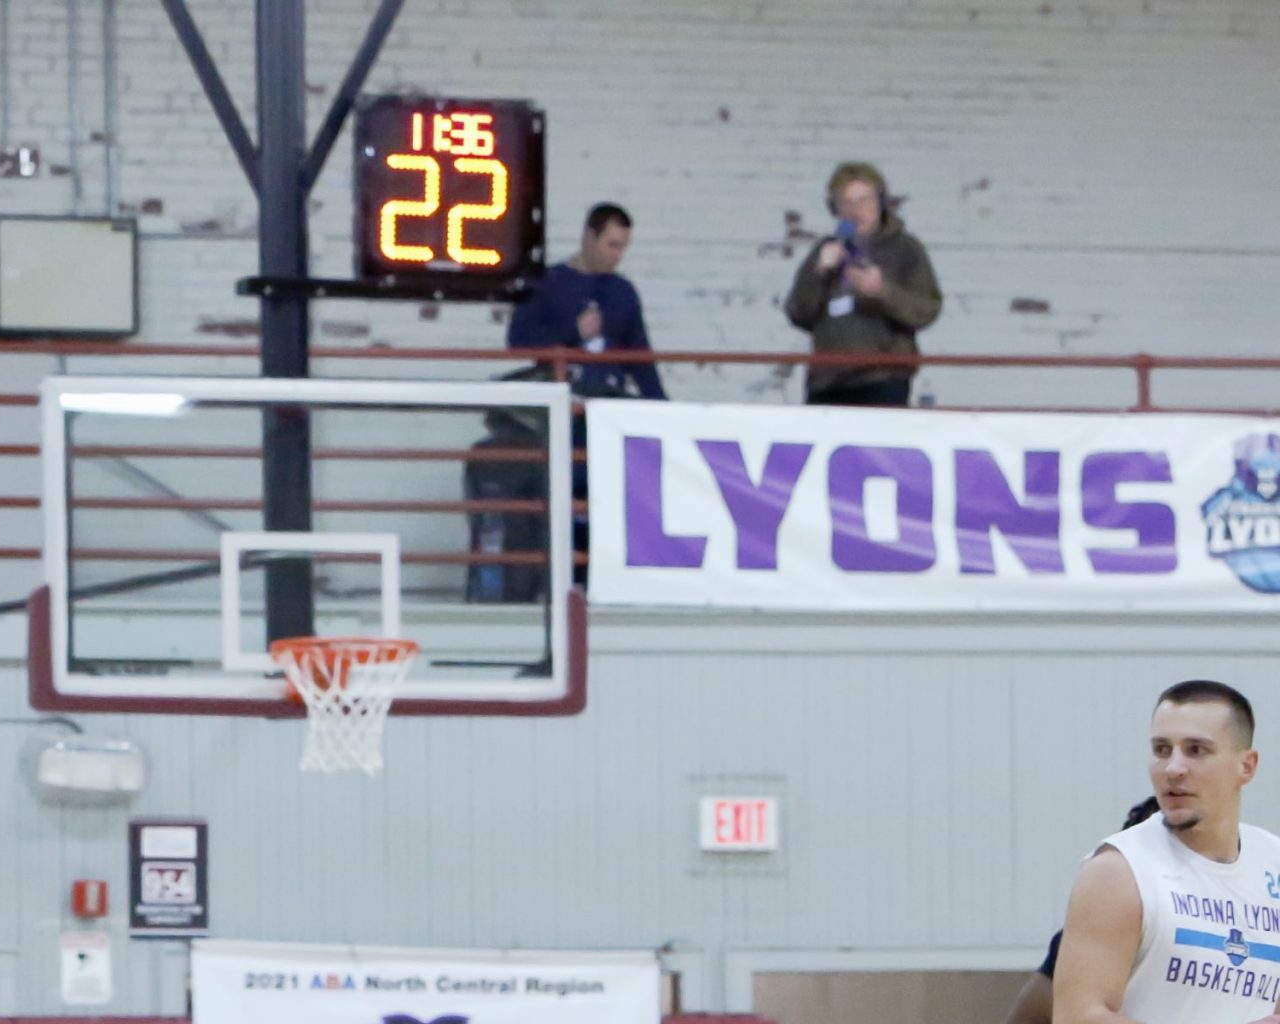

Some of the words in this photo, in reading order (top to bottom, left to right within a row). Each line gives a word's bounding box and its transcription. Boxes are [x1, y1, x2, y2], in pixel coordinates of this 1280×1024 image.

[380, 154, 508, 265] 22
[622, 435, 1178, 575] LYONS
[1209, 513, 1280, 553] LYO
[715, 800, 769, 846] EXIT
[1170, 890, 1236, 926] INDANA
[1244, 903, 1280, 933] LYON
[244, 972, 299, 990] 2021
[310, 973, 357, 990] ABA
[365, 975, 427, 992] North
[436, 976, 517, 993] Central
[526, 977, 605, 997] Region
